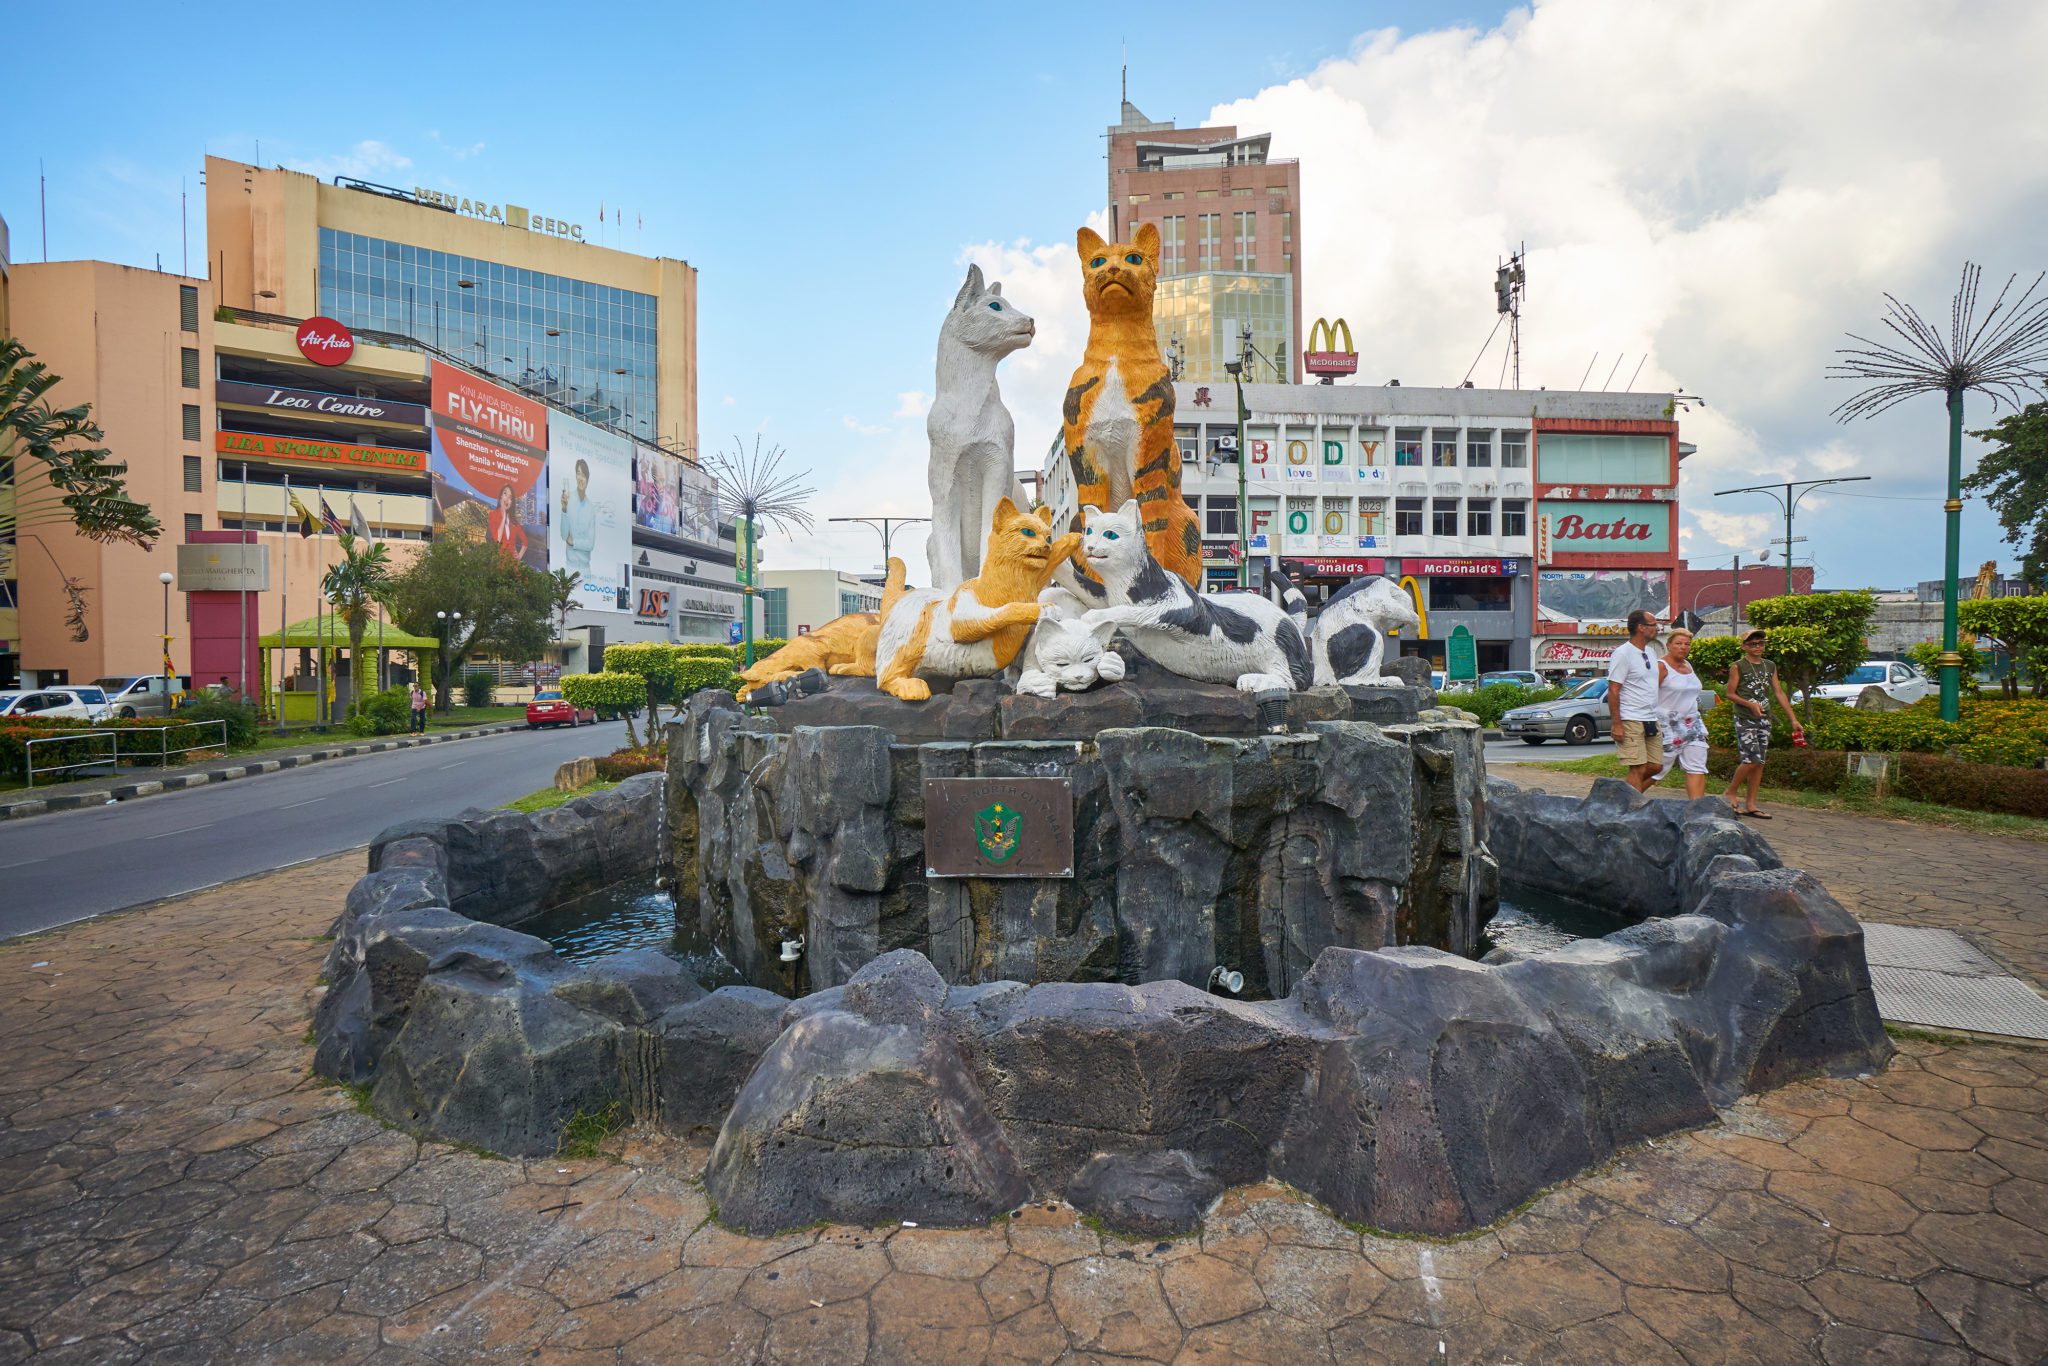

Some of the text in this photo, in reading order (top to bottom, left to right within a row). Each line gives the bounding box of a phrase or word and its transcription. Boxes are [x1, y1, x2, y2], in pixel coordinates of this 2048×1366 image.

[415, 186, 583, 238] MENARA SEDC
[264, 389, 385, 418] Lea Centre
[460, 385, 525, 417] KINI ANDA BOLEH
[448, 391, 534, 442] FLY-THRU
[224, 435, 420, 467] LEA SPORTS CENTRE
[456, 436, 529, 466] Shenzhen Guangzhou
[469, 453, 519, 474] Manila Wuhan
[1251, 440, 1379, 466] BODY
[1288, 467, 1313, 478] love
[1358, 468, 1386, 480] bdy
[1251, 510, 1379, 534] FOOT
[1552, 514, 1653, 540] Bata
[204, 567, 256, 575] MARGHERTA
[1317, 563, 1364, 572] onald's
[1424, 564, 1497, 573] McDonald's
[638, 588, 670, 619] LSC
[1586, 623, 1629, 635] Bata
[1579, 648, 1612, 660] Juala
[973, 784, 1018, 798] NORTH
[1020, 790, 1050, 812] CITY
